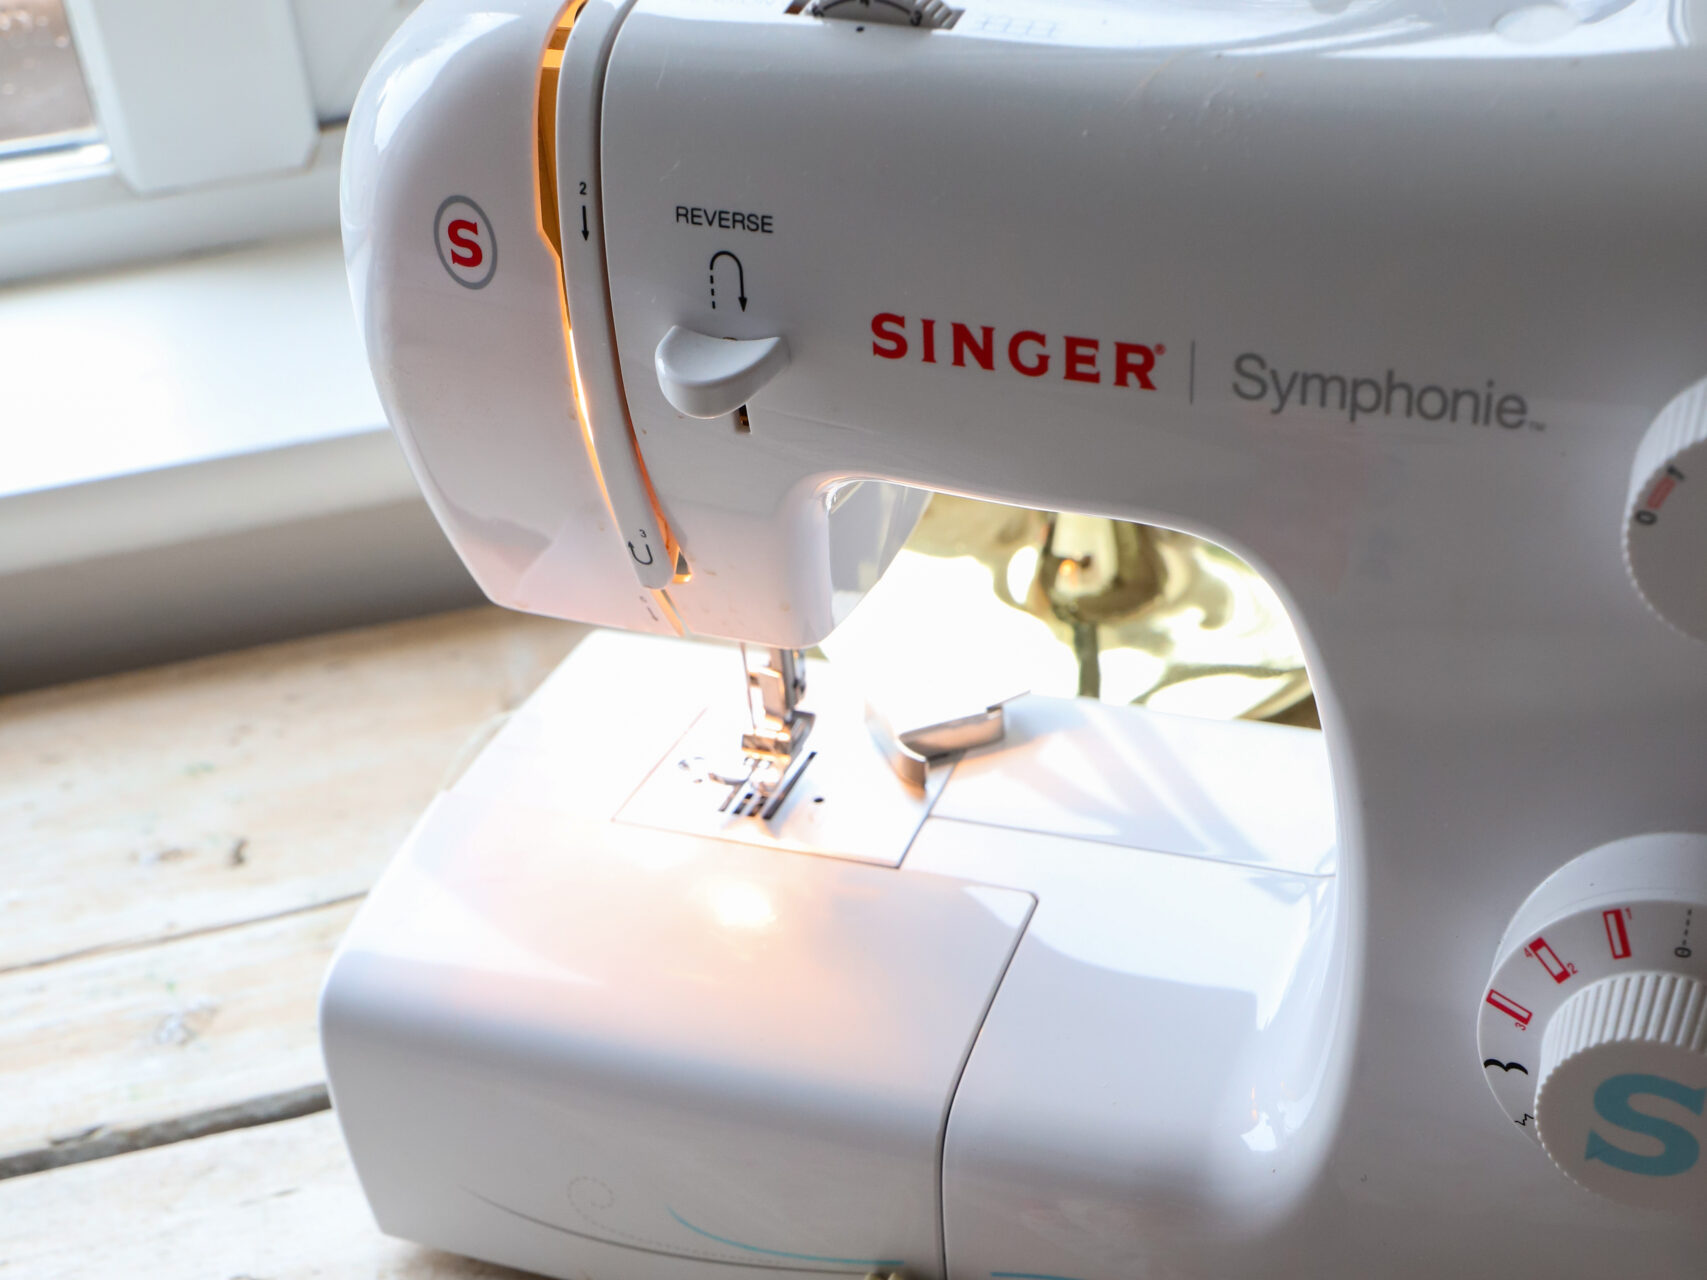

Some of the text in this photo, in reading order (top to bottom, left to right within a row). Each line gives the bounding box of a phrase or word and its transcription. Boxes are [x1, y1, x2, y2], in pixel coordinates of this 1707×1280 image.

[910, 10, 923, 27] 3
[579, 181, 587, 195] 2
[675, 205, 774, 234] REVERSE
[447, 219, 483, 268] S
[1635, 510, 1658, 526] 0
[639, 528, 648, 538] 3
[1624, 907, 1632, 920] 1
[1523, 946, 1535, 959] 4
[1566, 962, 1579, 976] 2
[1514, 1021, 1527, 1032] 3
[1584, 1072, 1707, 1177] S
